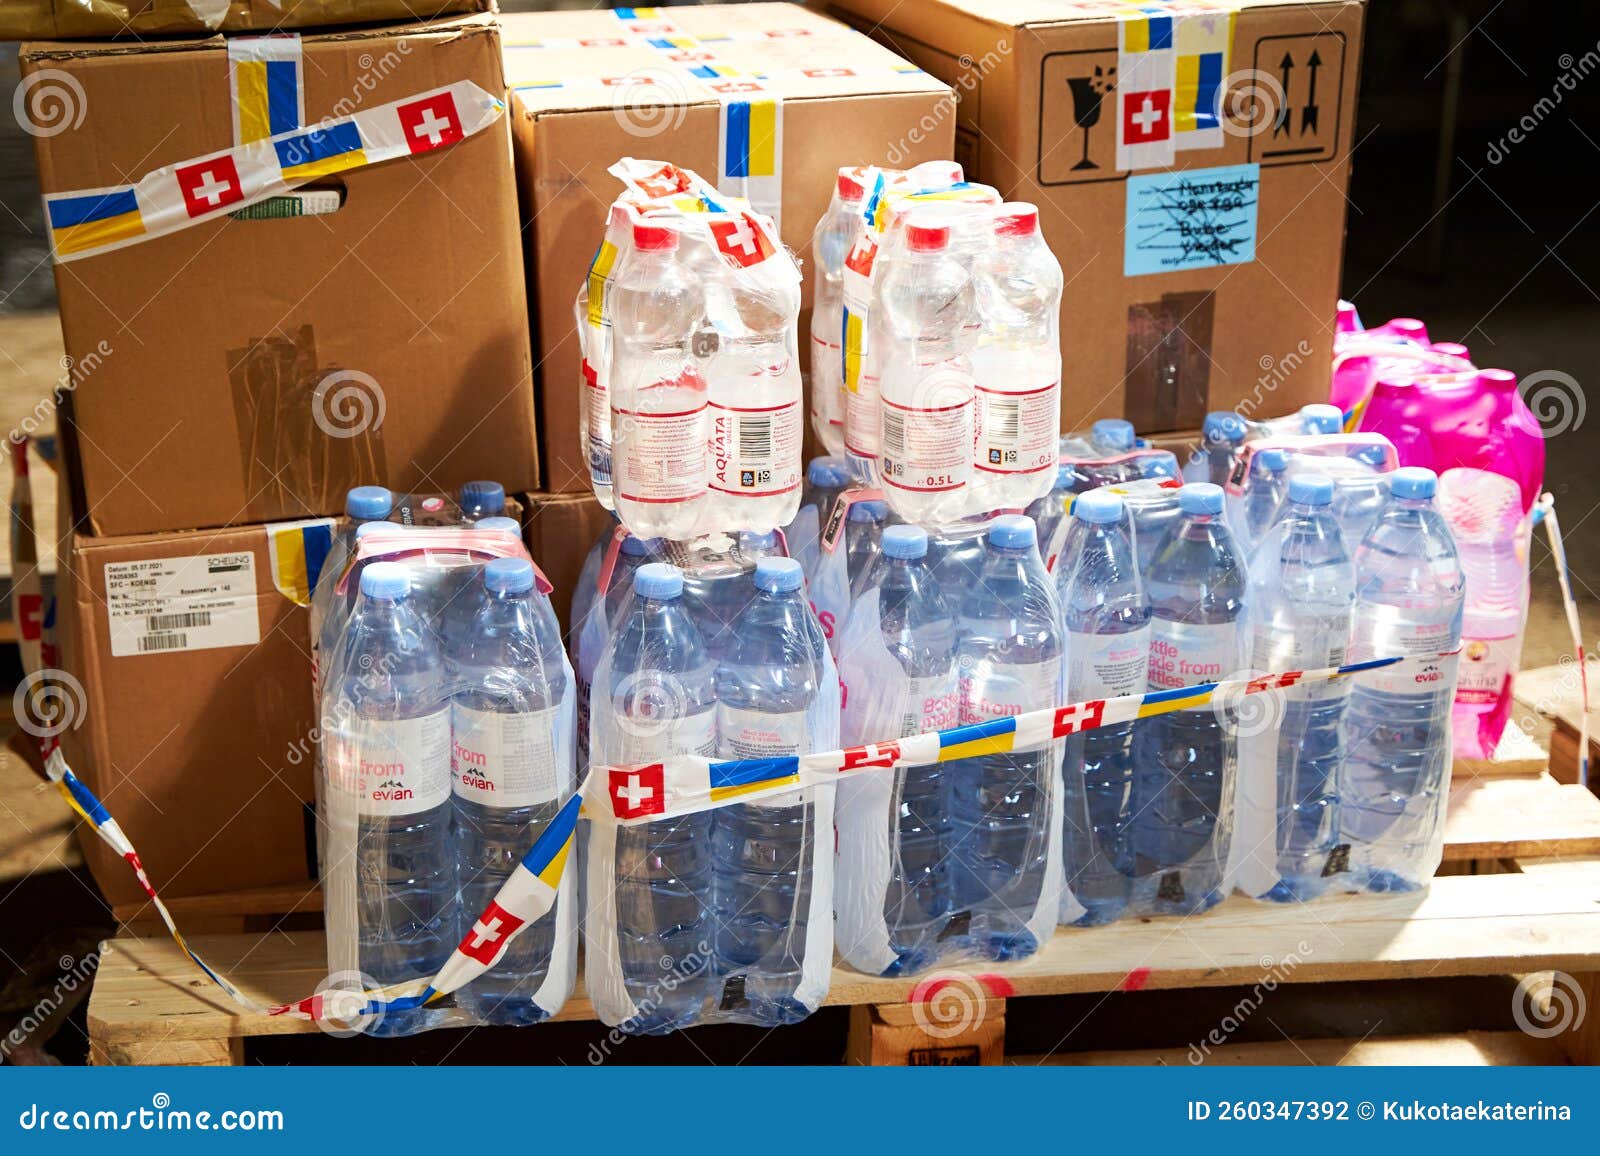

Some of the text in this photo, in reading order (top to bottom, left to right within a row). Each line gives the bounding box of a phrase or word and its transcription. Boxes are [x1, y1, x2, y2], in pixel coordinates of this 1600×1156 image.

[716, 417, 727, 483] AQUATA
[926, 475, 953, 486] 0.5 L
[208, 555, 250, 566] SCHELLING
[131, 579, 157, 587] KOENIG
[1179, 659, 1221, 675] from
[462, 775, 494, 792] evian
[373, 788, 413, 801] evian
